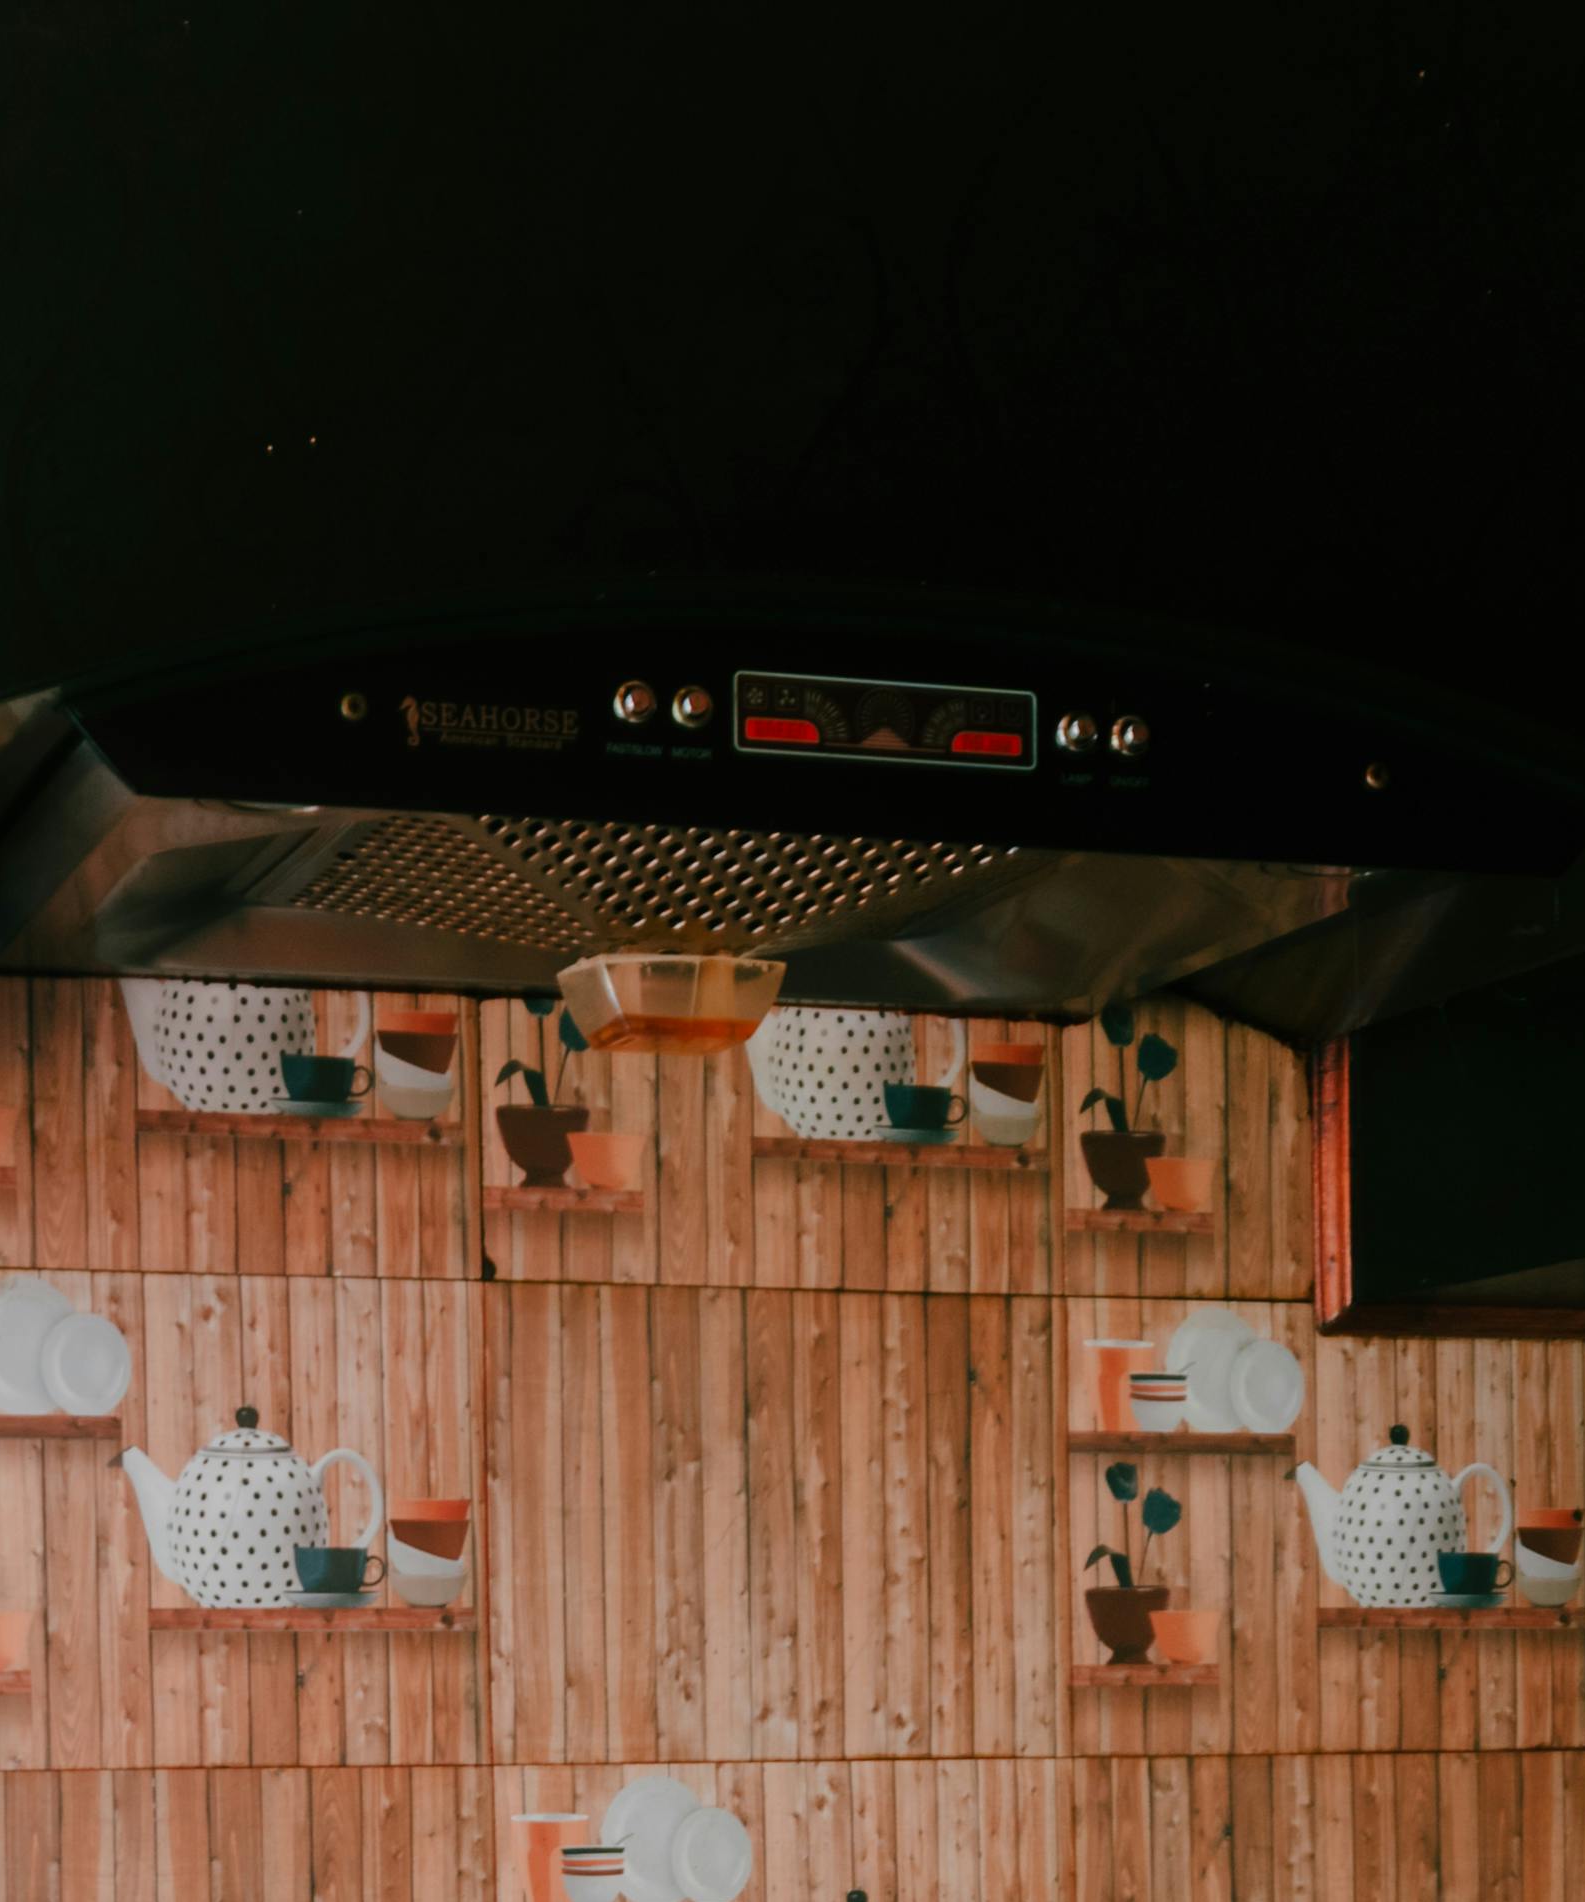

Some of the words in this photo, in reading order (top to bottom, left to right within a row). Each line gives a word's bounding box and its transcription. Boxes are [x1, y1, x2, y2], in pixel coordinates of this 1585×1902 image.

[420, 701, 581, 735] SEAHORSE
[440, 732, 499, 749] American
[506, 735, 563, 751] Standard
